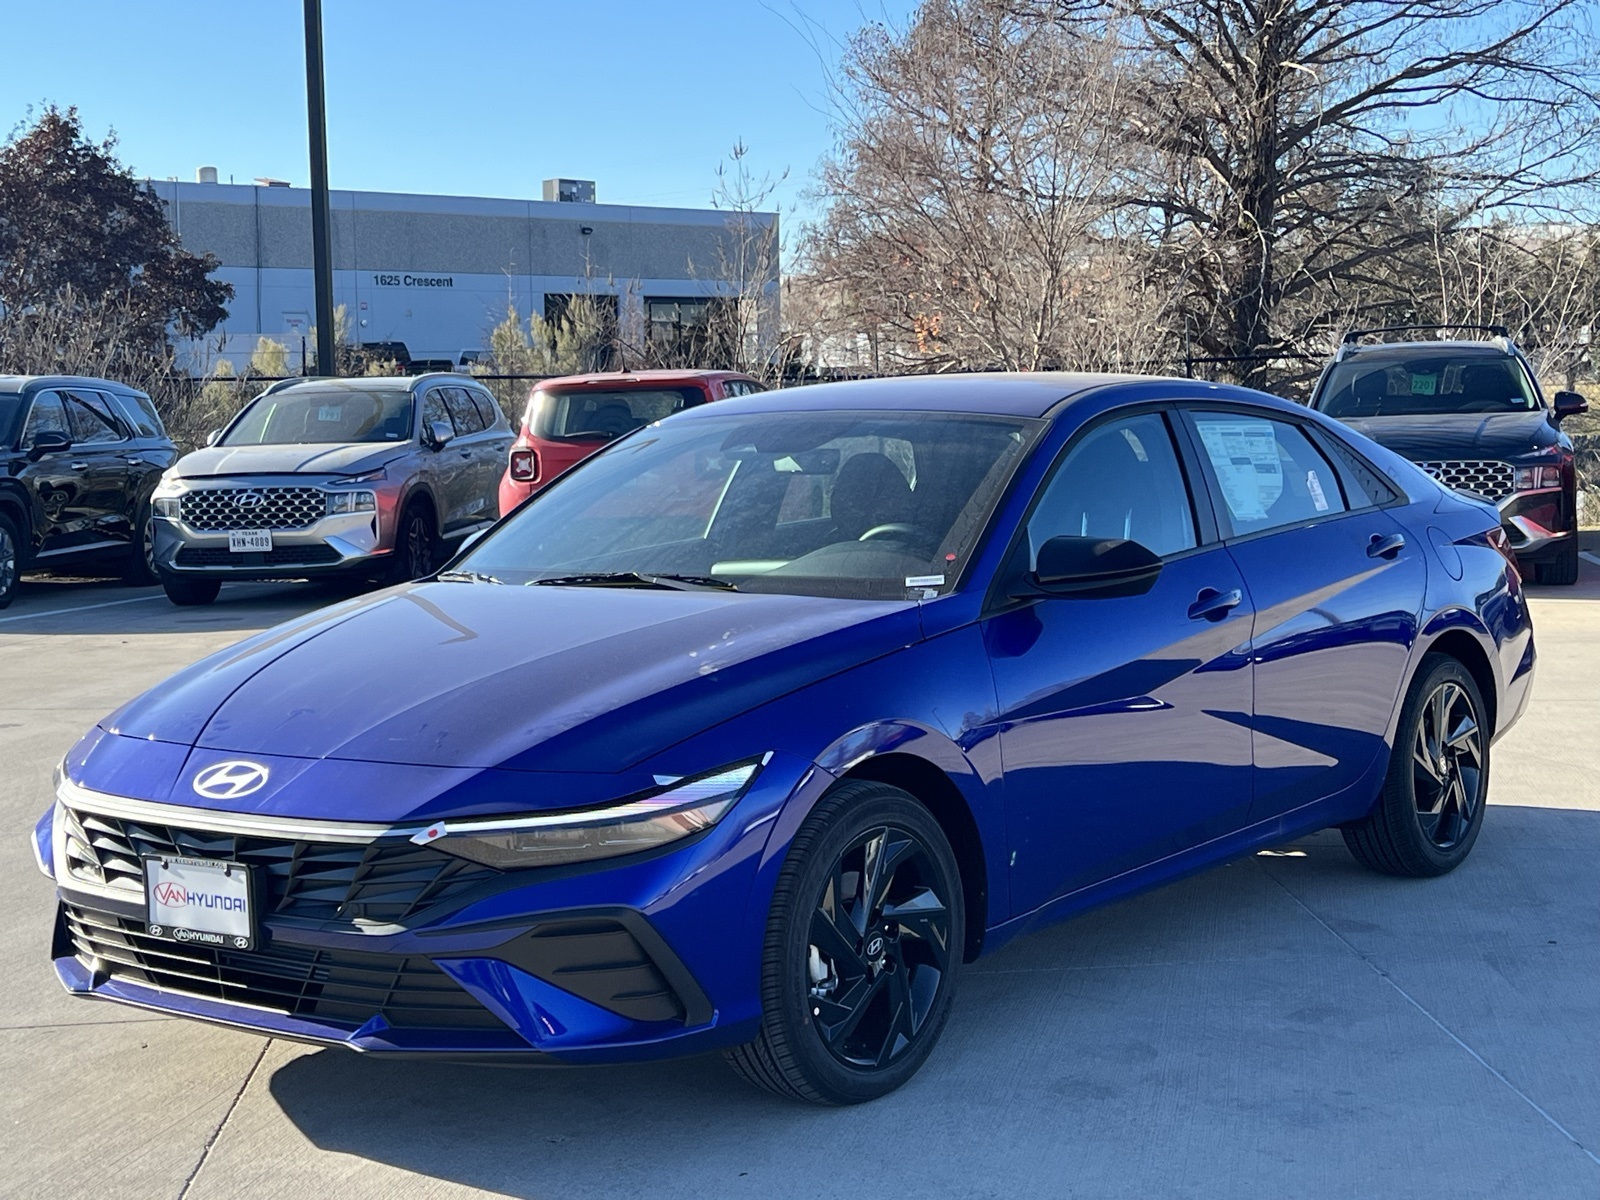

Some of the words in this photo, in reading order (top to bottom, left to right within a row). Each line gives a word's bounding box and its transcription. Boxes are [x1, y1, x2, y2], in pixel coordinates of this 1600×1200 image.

[373, 274, 400, 286] 1625
[403, 275, 453, 287] Crescent
[1412, 380, 1434, 390] 2201
[157, 882, 186, 905] VAN
[186, 891, 247, 913] HYUNDAI
[189, 931, 224, 944] HYUNDAI
